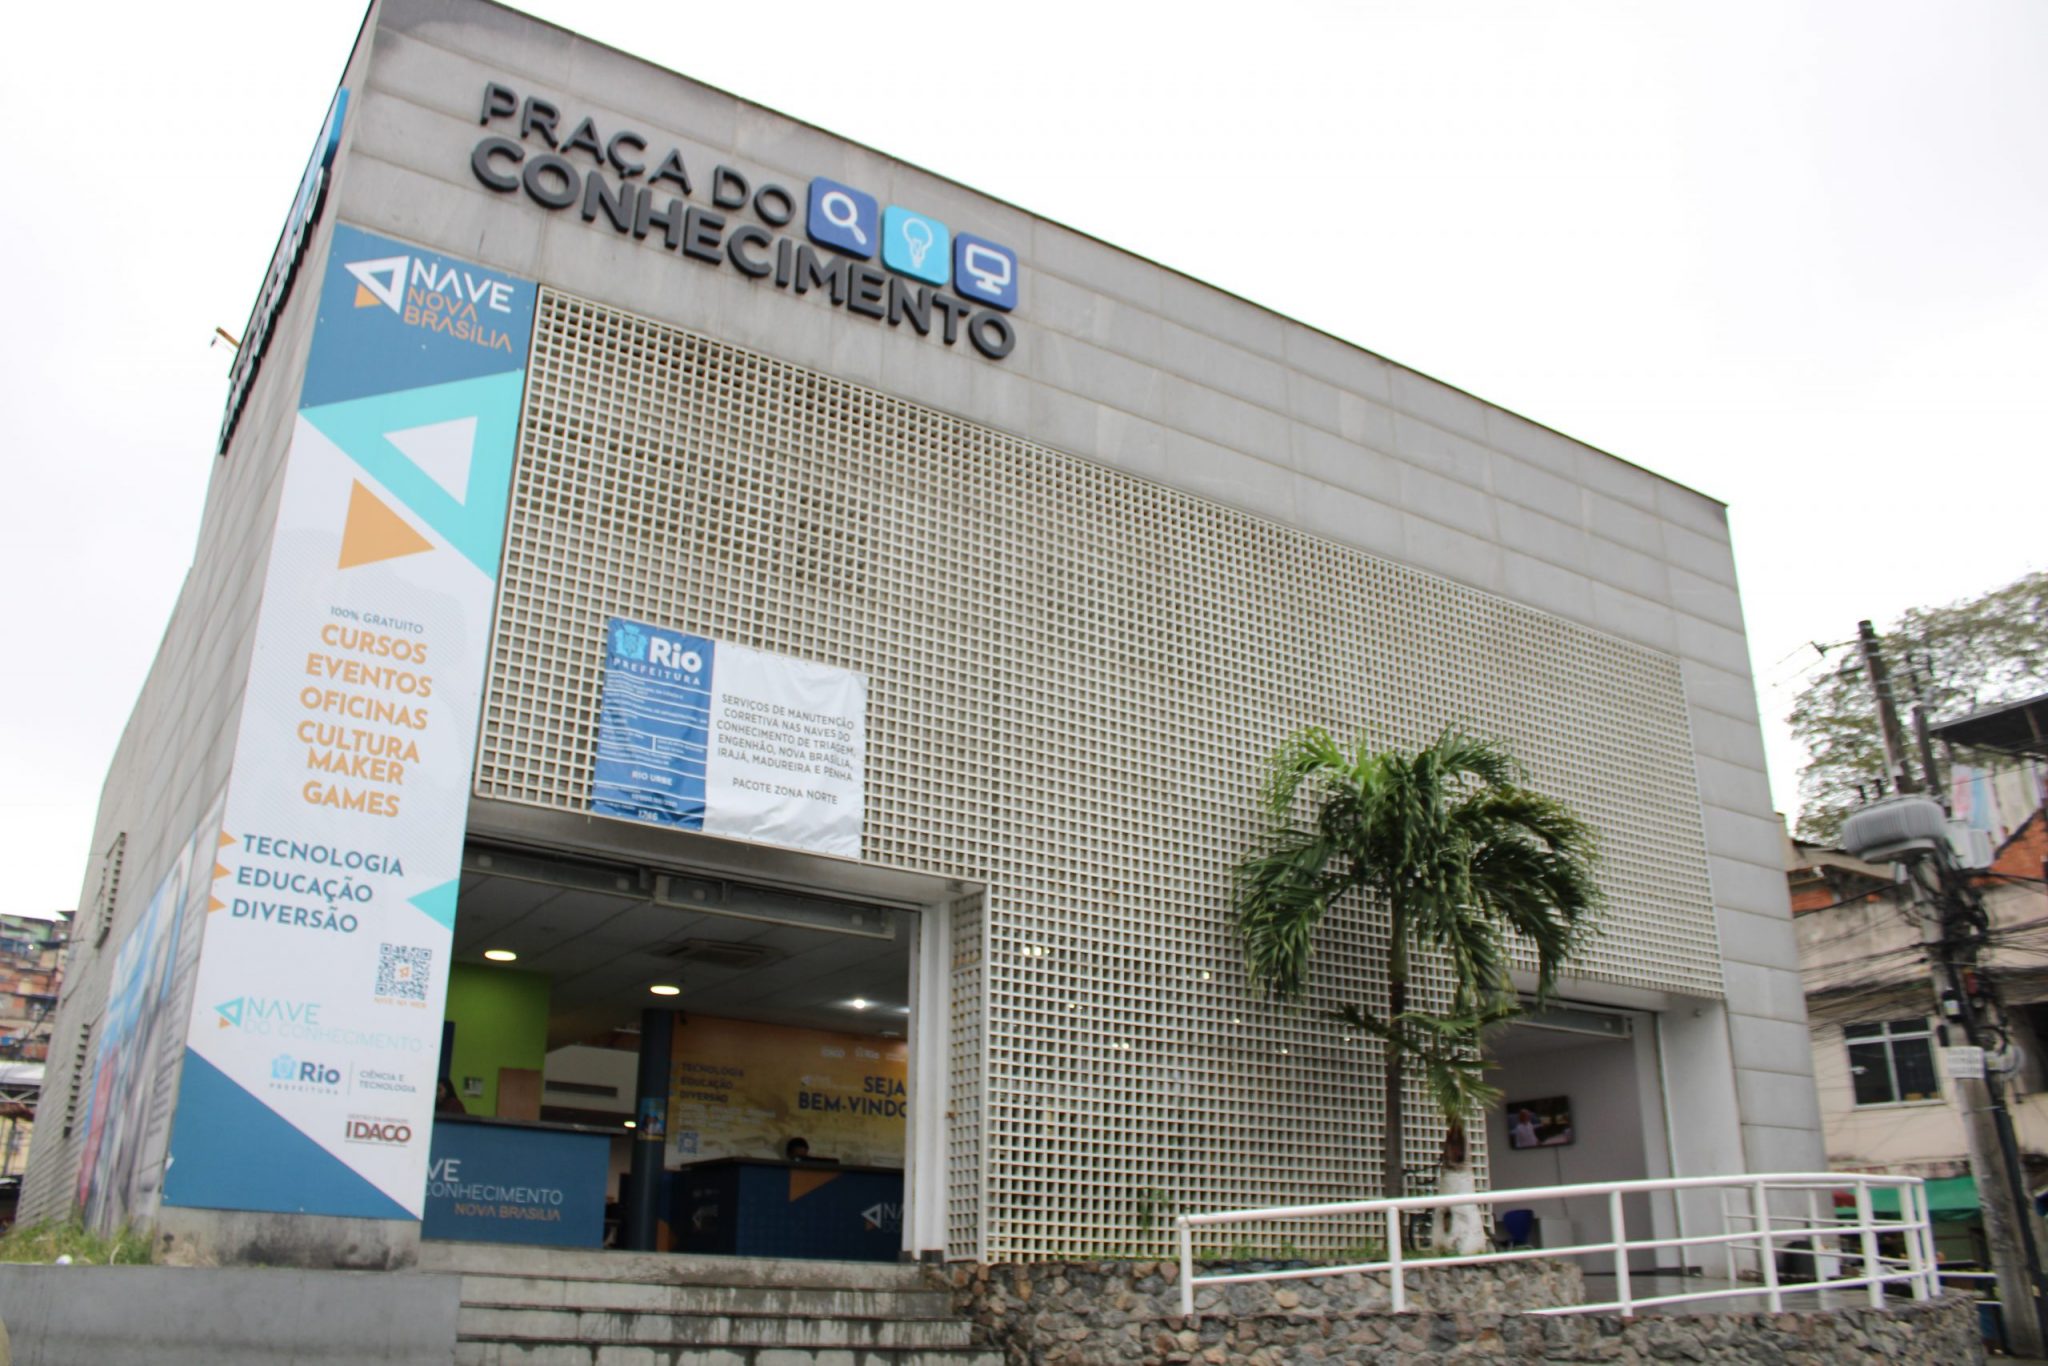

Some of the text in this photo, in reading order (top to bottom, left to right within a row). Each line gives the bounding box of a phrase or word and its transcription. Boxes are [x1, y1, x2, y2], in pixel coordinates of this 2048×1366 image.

[480, 81, 797, 227] PRAÇA DO
[471, 136, 1016, 360] CONHECIMENTO
[411, 257, 514, 313] NAVE
[407, 287, 477, 322] NOVA
[330, 606, 424, 634] 100% GRATUITO
[321, 623, 428, 665] CURSOS
[650, 636, 702, 673] Rio
[305, 652, 433, 698] EVENTOS
[613, 658, 701, 686] PREFEITURA
[300, 686, 428, 730] OFICINAS
[722, 693, 769, 713] SERVIÇOS
[772, 704, 786, 716] DE
[788, 708, 855, 731] MANUTENÇÃO
[724, 707, 851, 742] CORRETIVA NAS NAVES DO
[297, 720, 420, 764] CULTURA
[716, 719, 795, 744] CONHECIMENTO
[797, 736, 811, 748] DE
[306, 747, 405, 785] MAKER
[752, 755, 811, 773] MADUREIRA
[815, 765, 821, 774] E
[779, 746, 806, 760] NOVA
[303, 780, 401, 818] GAMES
[732, 777, 838, 805] PACOTE ZONA NORTE
[243, 833, 404, 877] TECNOLOGIA
[237, 865, 373, 903] EDUCAÇÃO
[232, 897, 358, 933] DIVERSÃO
[247, 996, 320, 1025] NAVE
[244, 1020, 422, 1053] DO CONHECIMENTO
[300, 1061, 340, 1085] Rio
[864, 1076, 906, 1097] SEJA
[346, 1120, 411, 1143] IDACO
[427, 1158, 461, 1182] VE
[455, 1203, 496, 1216] NOVA
